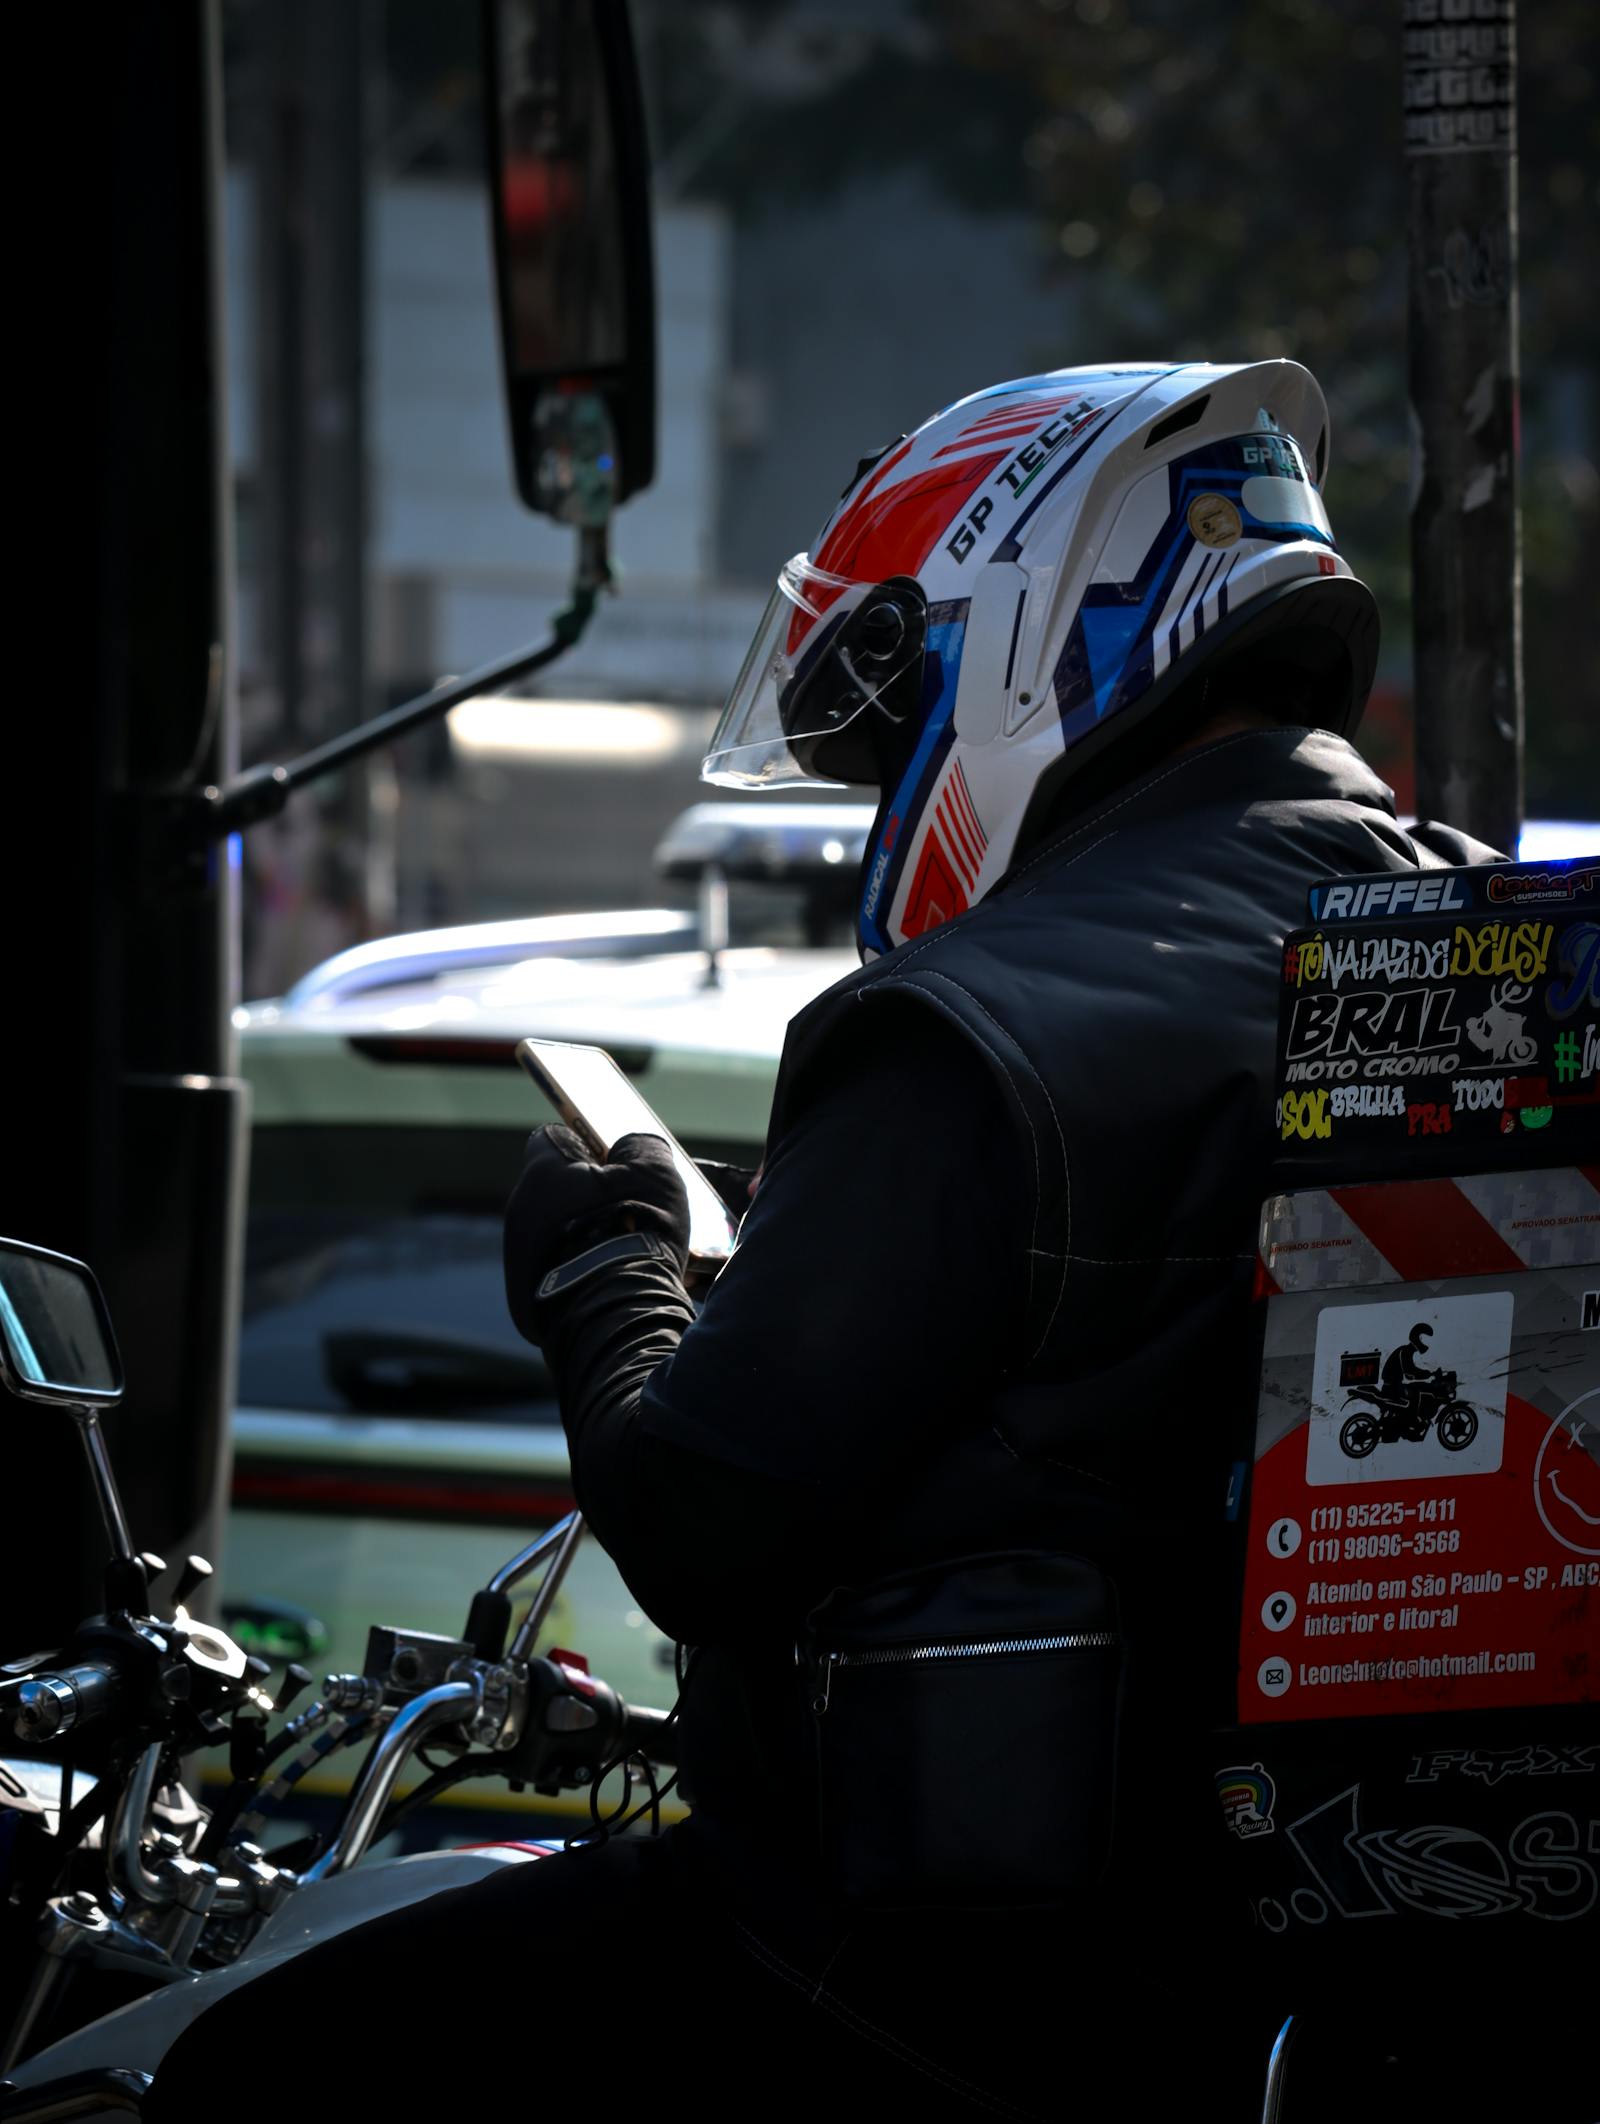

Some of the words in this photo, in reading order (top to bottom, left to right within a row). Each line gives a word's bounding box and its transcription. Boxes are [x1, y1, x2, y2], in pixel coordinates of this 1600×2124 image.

[1243, 446, 1274, 464] GP
[946, 497, 995, 565] GP
[994, 395, 1096, 490] TECH
[863, 852, 889, 920] RADICAL
[1321, 876, 1465, 921] RIFFEL
[1285, 986, 1462, 1061] BRAL
[1285, 1059, 1358, 1083] MOTO
[1362, 1053, 1461, 1079] CROMO
[1281, 1086, 1333, 1142] SOL
[1329, 1083, 1408, 1120] BRILHA
[1406, 1100, 1455, 1138] PRA
[1511, 1218, 1556, 1230] APROVADO
[1310, 1503, 1343, 1533] (11)
[1346, 1498, 1457, 1530] 95225-1411
[1308, 1539, 1341, 1565] (11)
[1343, 1529, 1461, 1561] 98096-3568
[1306, 1581, 1372, 1606] Atendo
[1376, 1580, 1407, 1600] em
[1411, 1573, 1447, 1599] São
[1450, 1569, 1503, 1597] Paulo
[1523, 1566, 1549, 1592] SP
[1303, 1614, 1380, 1638] interior
[1383, 1613, 1395, 1632] e
[1399, 1604, 1460, 1631] litoral
